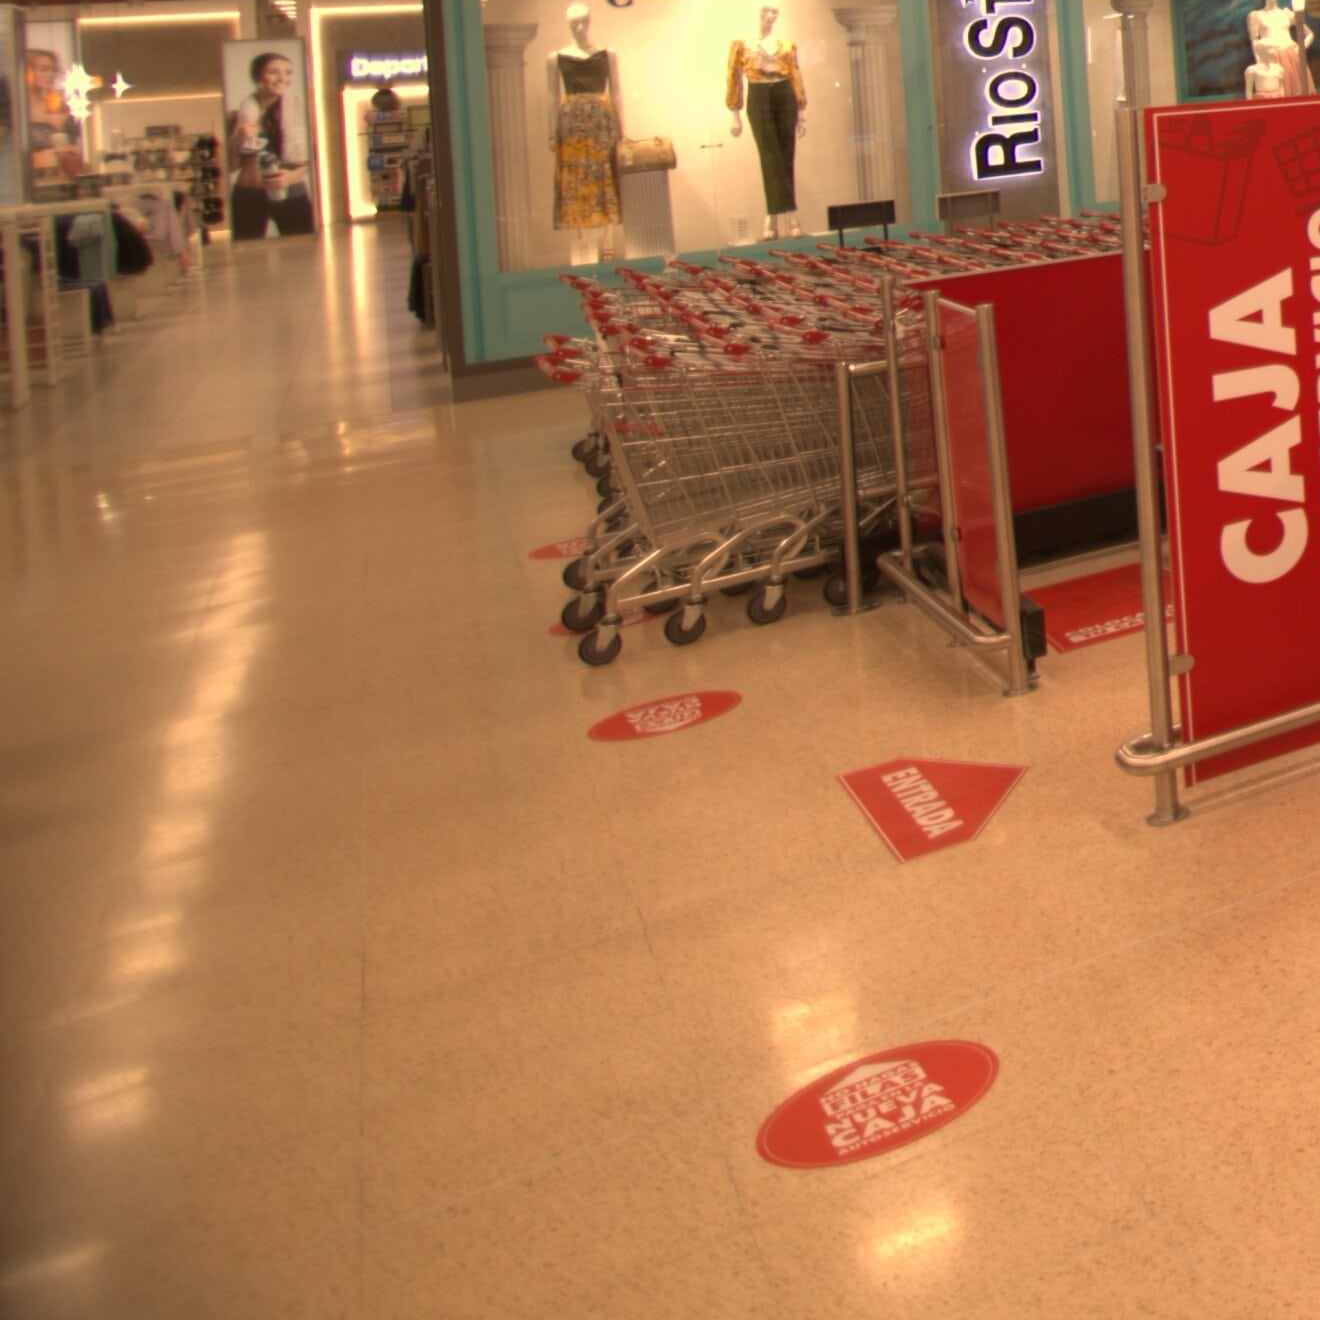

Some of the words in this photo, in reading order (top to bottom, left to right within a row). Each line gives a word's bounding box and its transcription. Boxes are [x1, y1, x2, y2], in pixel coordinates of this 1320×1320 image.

[972, 70, 1044, 181] RIO
[1208, 267, 1309, 584] CAJA
[881, 766, 963, 839] ENTRADA
[825, 1082, 945, 1135] NUEVA
[829, 1069, 921, 1113] FILAS
[831, 1094, 953, 1147] CAJA
[838, 1103, 956, 1157] AUTOSERVICIO
